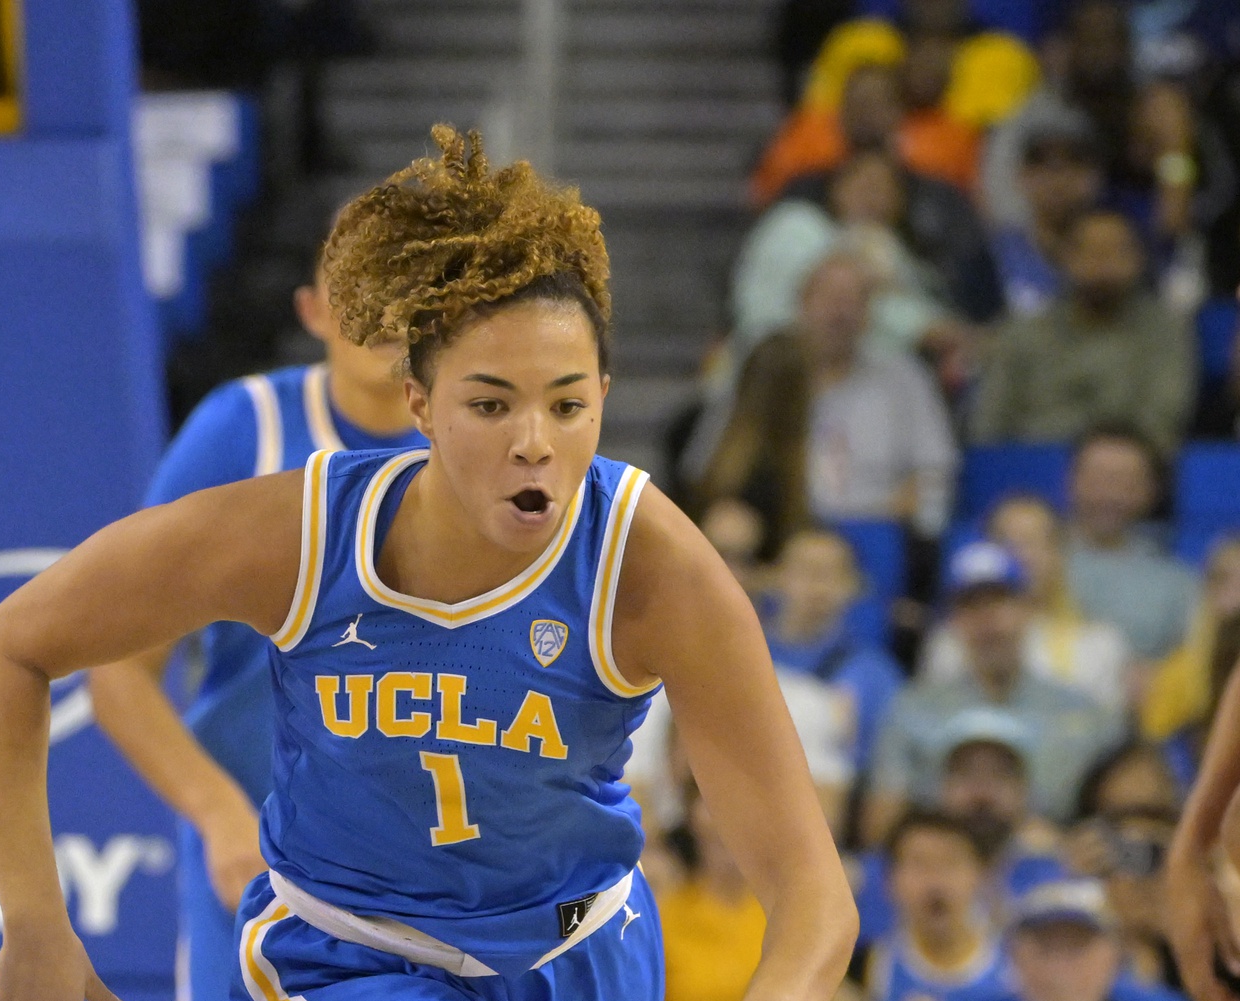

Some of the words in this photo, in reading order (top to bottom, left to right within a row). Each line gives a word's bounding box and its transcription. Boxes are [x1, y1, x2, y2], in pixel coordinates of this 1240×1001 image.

[538, 640, 555, 657] 12
[315, 672, 568, 760] UCLA
[419, 751, 481, 847] 1
